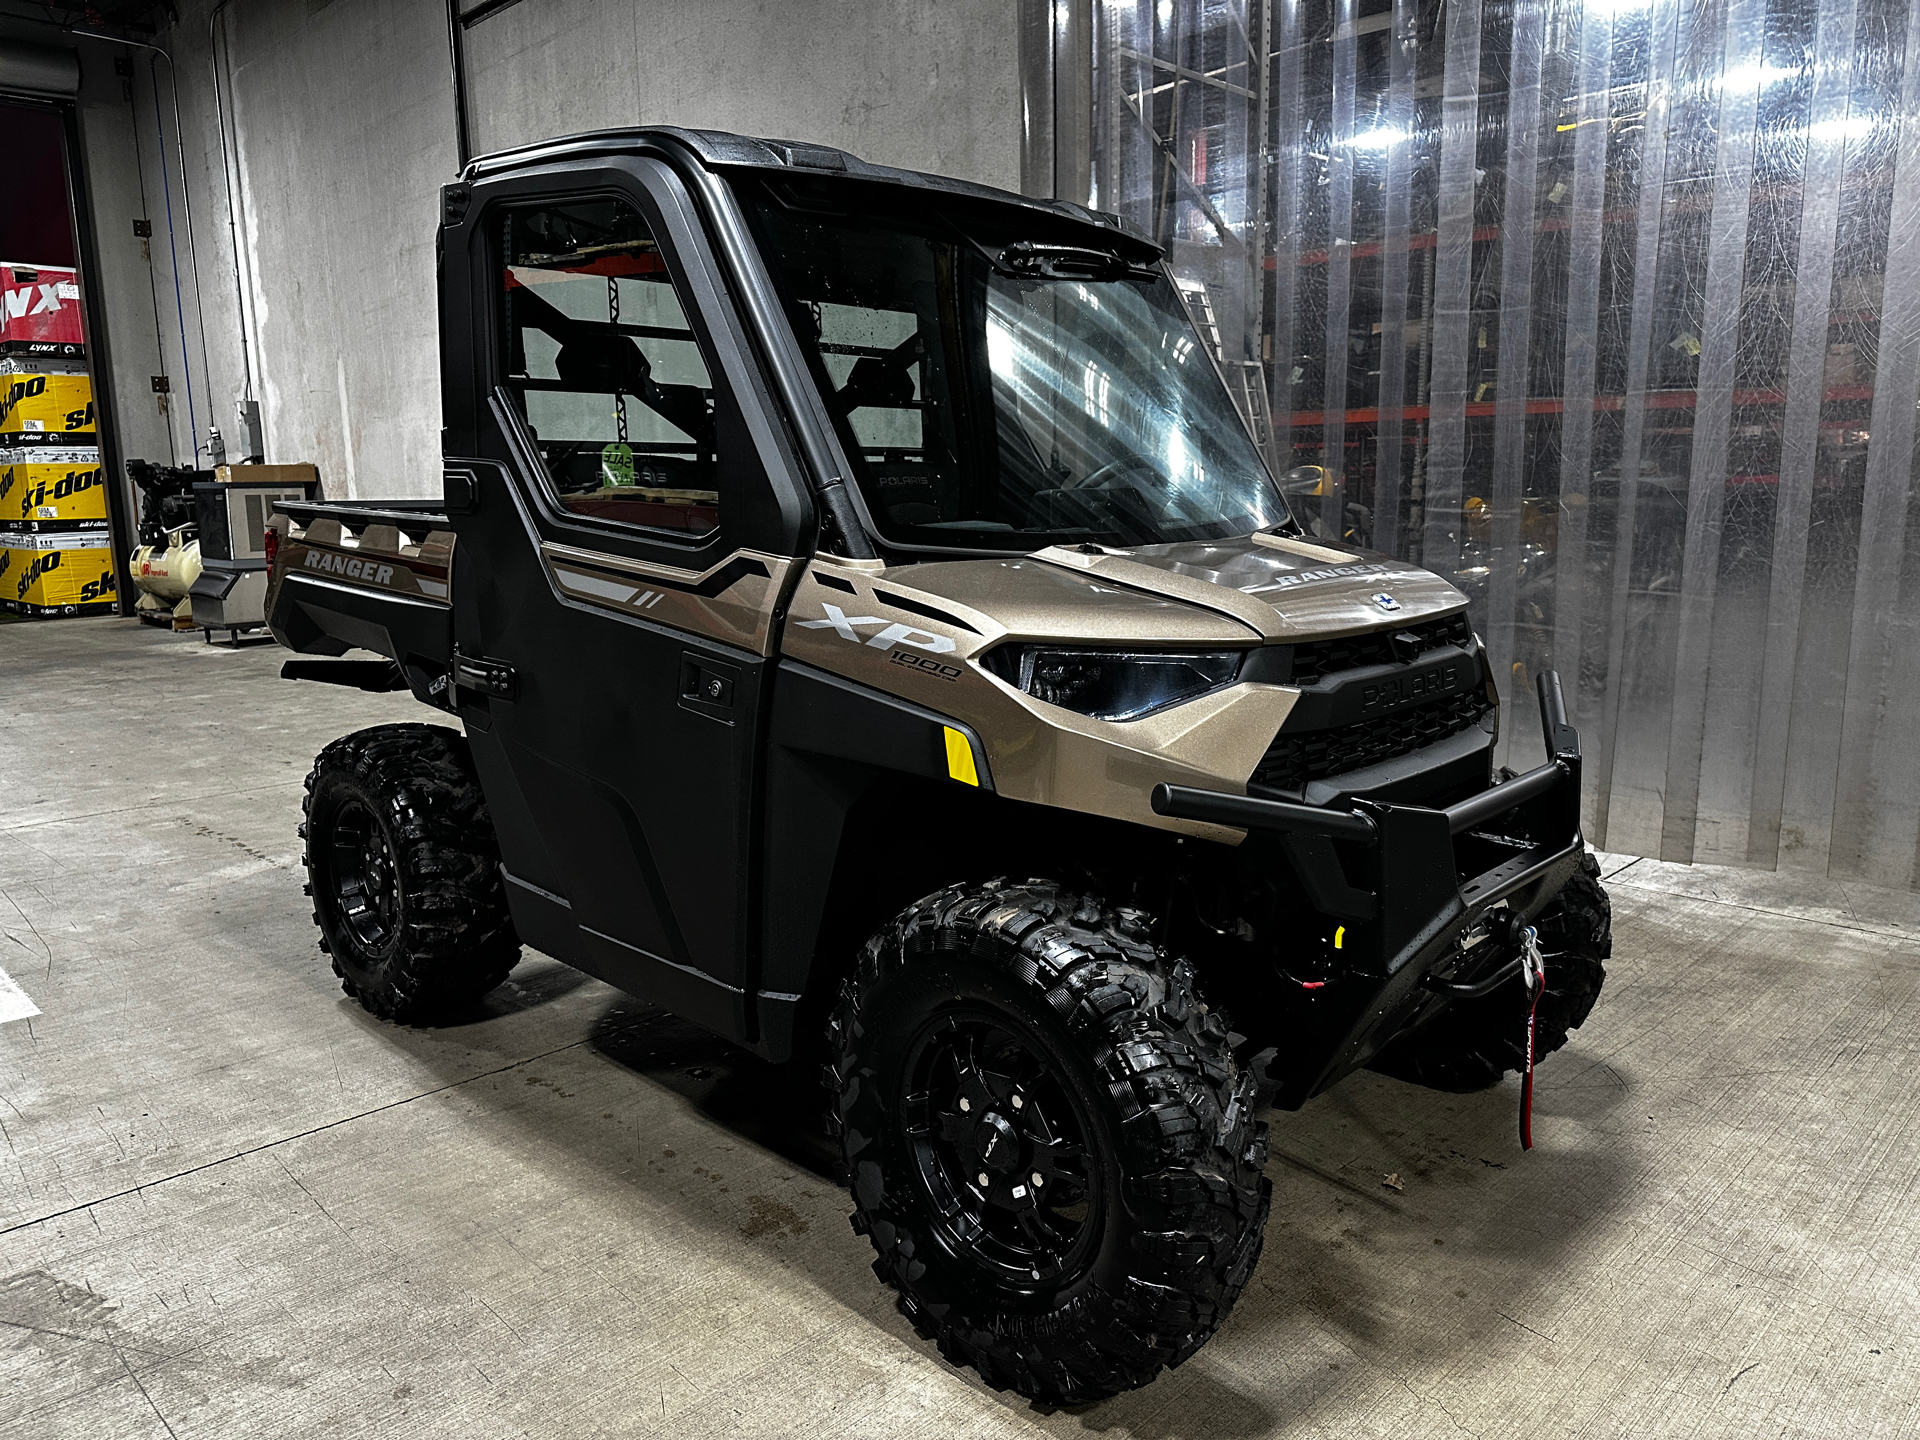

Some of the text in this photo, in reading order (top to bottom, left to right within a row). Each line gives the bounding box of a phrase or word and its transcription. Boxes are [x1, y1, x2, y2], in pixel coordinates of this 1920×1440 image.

[0, 280, 70, 334] NX
[29, 344, 57, 352] LYNX
[879, 476, 928, 487] POLARIS
[17, 551, 61, 600] ski-doo
[303, 549, 394, 585] RANGER
[1275, 564, 1390, 586] RANGER
[794, 602, 957, 653] XP
[890, 650, 963, 678] 1000
[1362, 664, 1457, 713] POLARIS
